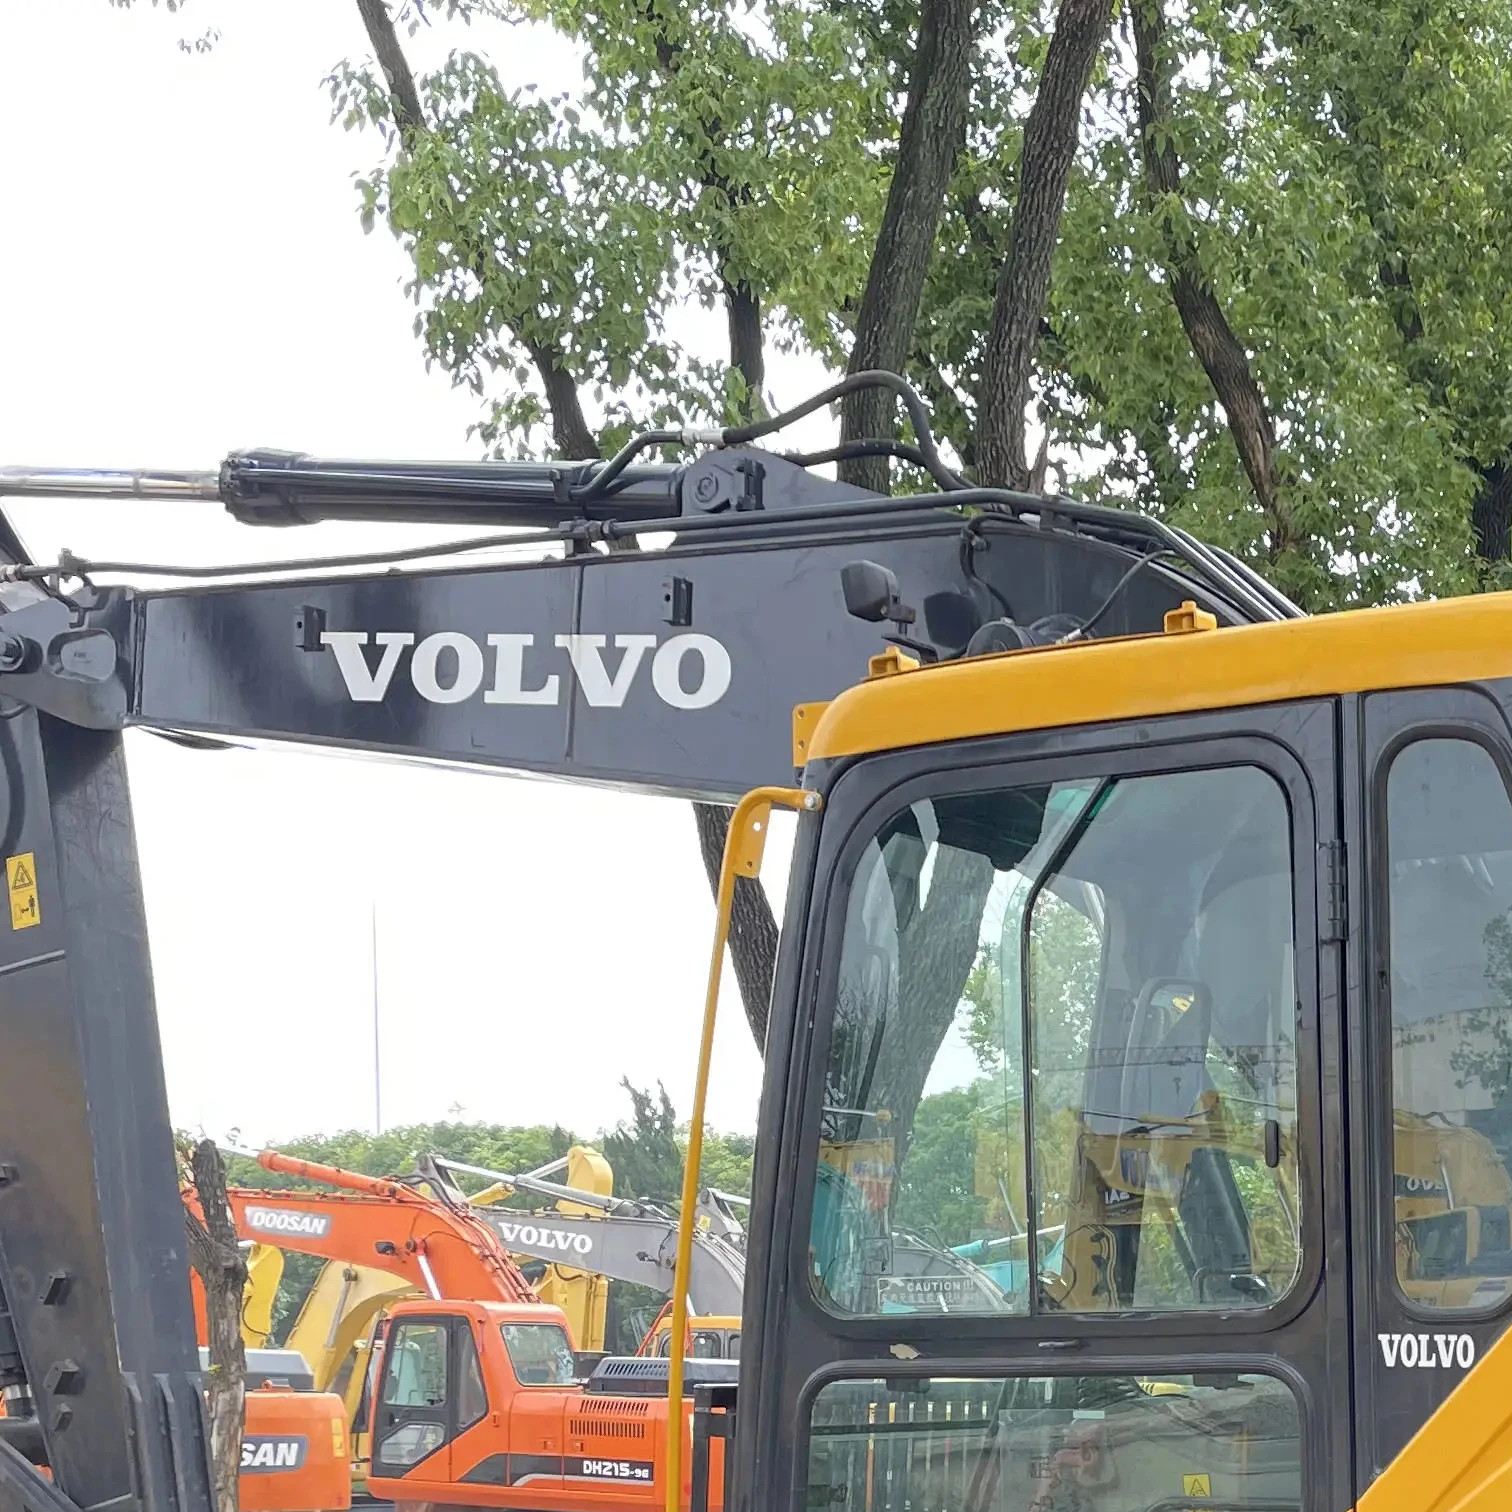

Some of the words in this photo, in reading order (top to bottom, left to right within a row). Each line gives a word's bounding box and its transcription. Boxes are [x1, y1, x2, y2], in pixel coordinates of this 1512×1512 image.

[320, 632, 731, 709] VOLVO
[251, 1211, 326, 1234] DOOSAN
[498, 1222, 593, 1254] VOLVO
[1377, 1333, 1475, 1368] VOLVO
[240, 1443, 299, 1467] SAN
